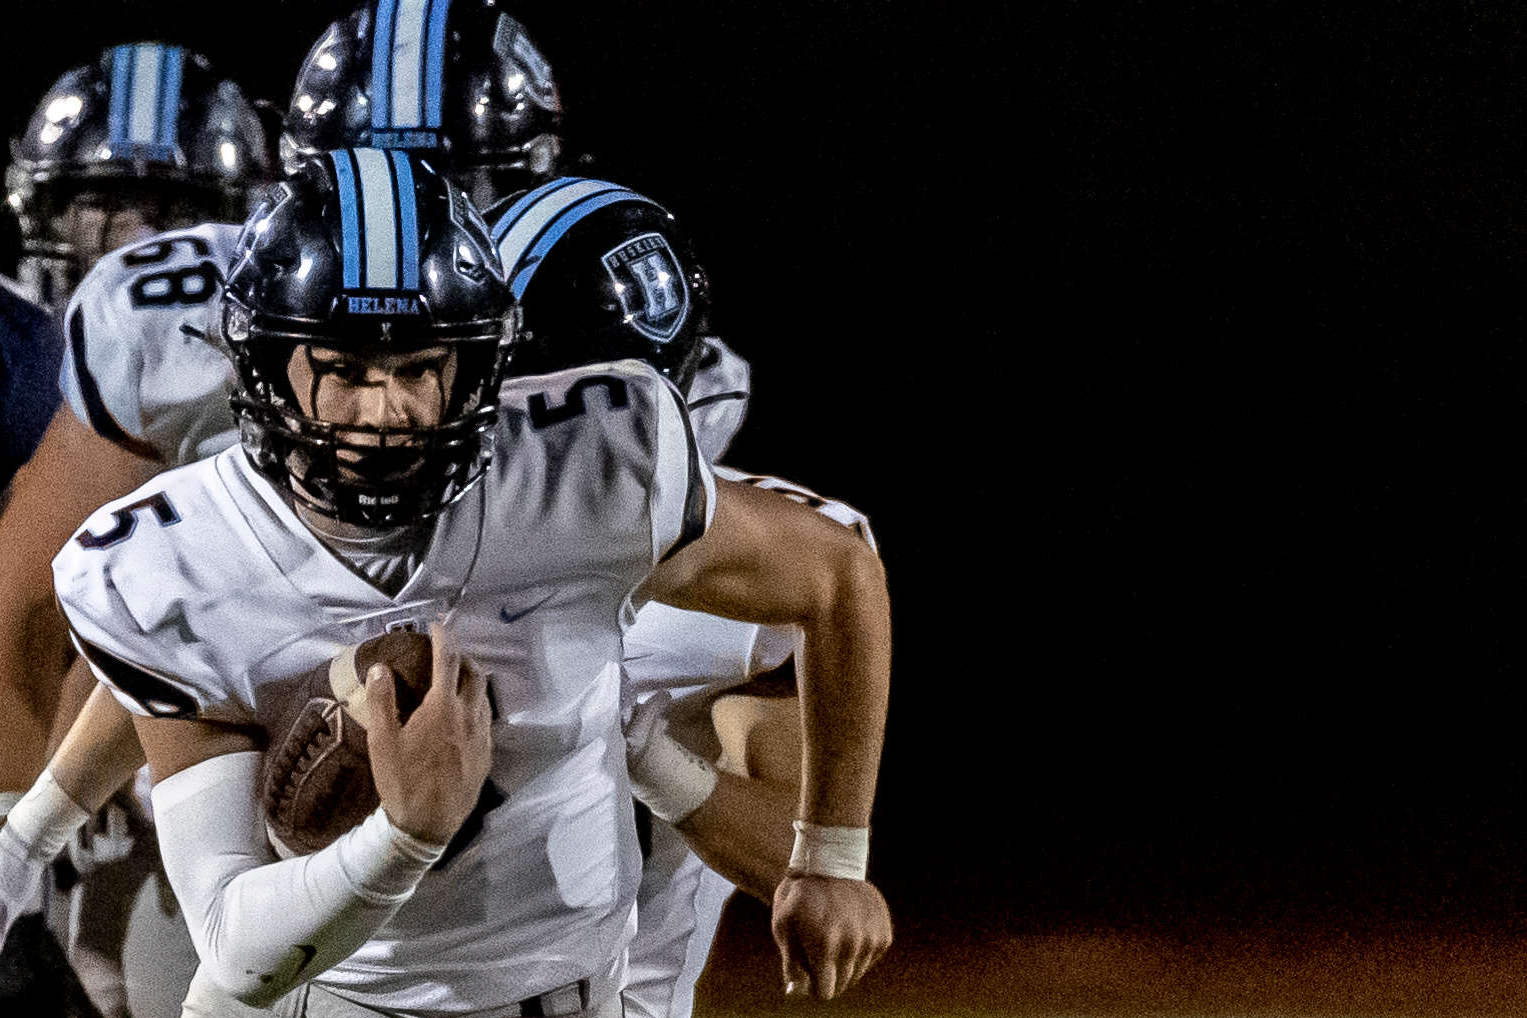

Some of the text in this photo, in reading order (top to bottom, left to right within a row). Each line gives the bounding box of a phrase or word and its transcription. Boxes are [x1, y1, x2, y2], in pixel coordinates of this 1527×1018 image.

[347, 296, 421, 315] HELENA
[526, 374, 630, 432] 5
[74, 490, 183, 551] 5
